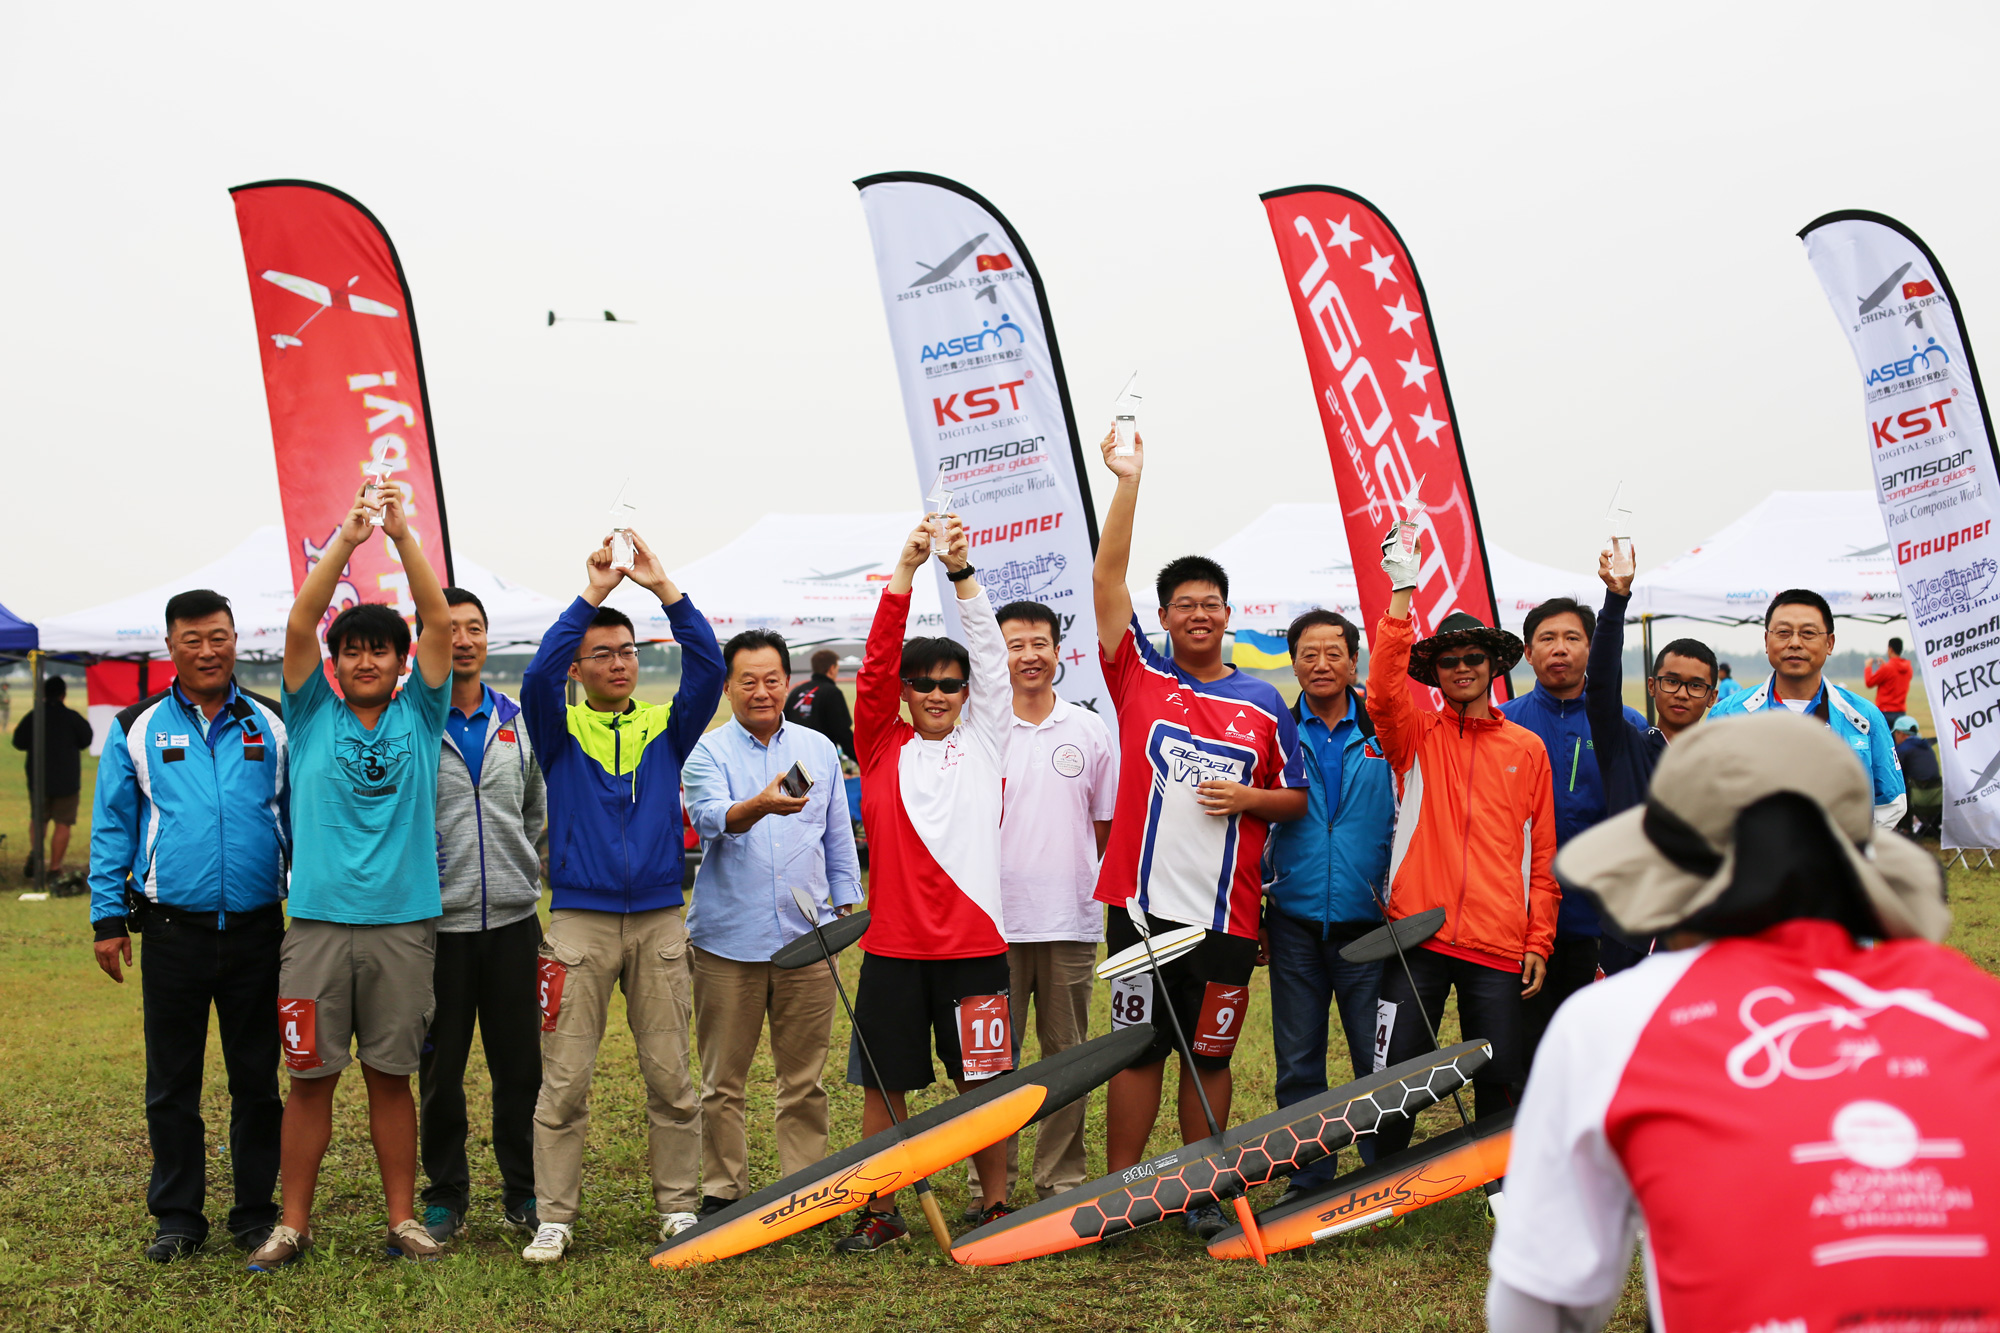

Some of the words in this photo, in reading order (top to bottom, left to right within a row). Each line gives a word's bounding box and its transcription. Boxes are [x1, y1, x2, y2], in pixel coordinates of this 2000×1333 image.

[897, 290, 921, 302] 2015
[927, 280, 966, 295] CHINA
[969, 275, 992, 286] F3K
[994, 271, 1025, 283] OPEN
[1861, 309, 1896, 325] CHINA
[1898, 302, 1918, 315] F3K
[1919, 295, 1946, 308] OPEN
[933, 380, 1025, 427] KST
[938, 423, 989, 441] DIGITAL
[991, 414, 1029, 430] SERVO
[1872, 398, 1952, 448] KST
[939, 436, 1045, 471] armsoar
[1878, 442, 1922, 462] DIGITAL
[942, 463, 1005, 485] composite
[1008, 453, 1049, 472] gliders
[1881, 449, 1973, 491] armsoar
[972, 483, 1025, 503] Composite
[1027, 473, 1056, 491] World
[1888, 512, 1909, 527] Peak
[1910, 496, 1958, 519] Composite
[1897, 519, 1991, 566] Graupner
[986, 576, 1031, 604] odel
[1907, 558, 1998, 601] Vladimir's
[1243, 604, 1278, 615] KST
[1912, 586, 1971, 619] Model
[1932, 654, 1949, 668] CBB
[1954, 794, 1979, 807] 2015
[540, 980, 549, 1008] 5
[1112, 990, 1145, 1022] 48
[285, 1021, 301, 1048] 4
[972, 1018, 1004, 1048] 10
[1216, 1007, 1235, 1034] 9
[1194, 1041, 1208, 1051] KST
[1376, 1024, 1388, 1052] 4
[963, 1059, 977, 1067] KST
[759, 1173, 853, 1225] Snipe
[1317, 1175, 1419, 1222] Snipe
